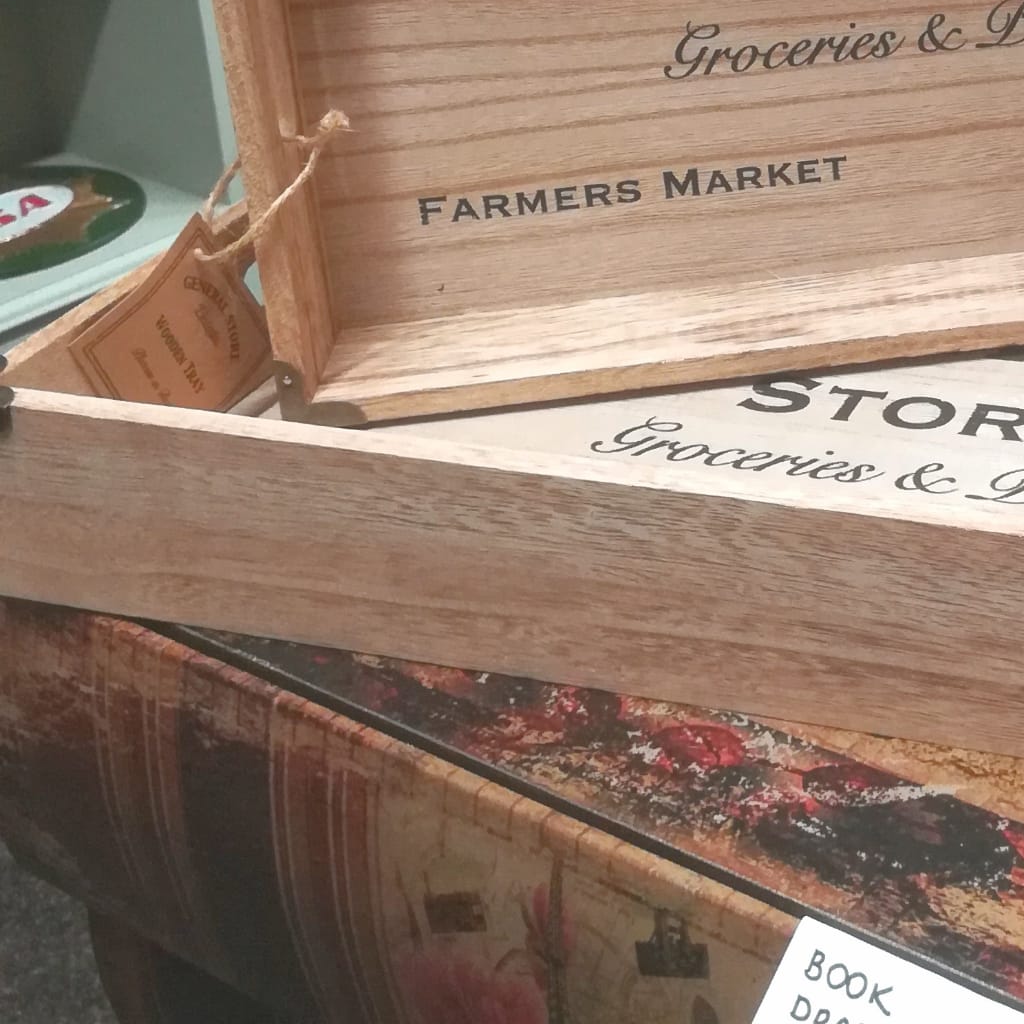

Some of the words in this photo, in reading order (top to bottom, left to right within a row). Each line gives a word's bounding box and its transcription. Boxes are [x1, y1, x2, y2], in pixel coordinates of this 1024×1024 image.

[664, 20, 905, 80] Groceries
[917, 13, 966, 54] &
[417, 178, 643, 227] FARMERS
[662, 156, 848, 201] MARKET
[155, 314, 188, 366] WOODEN
[182, 360, 207, 395] TRAY
[590, 415, 887, 484] Groceries
[894, 462, 959, 495] &
[804, 948, 894, 1017] BOOK
